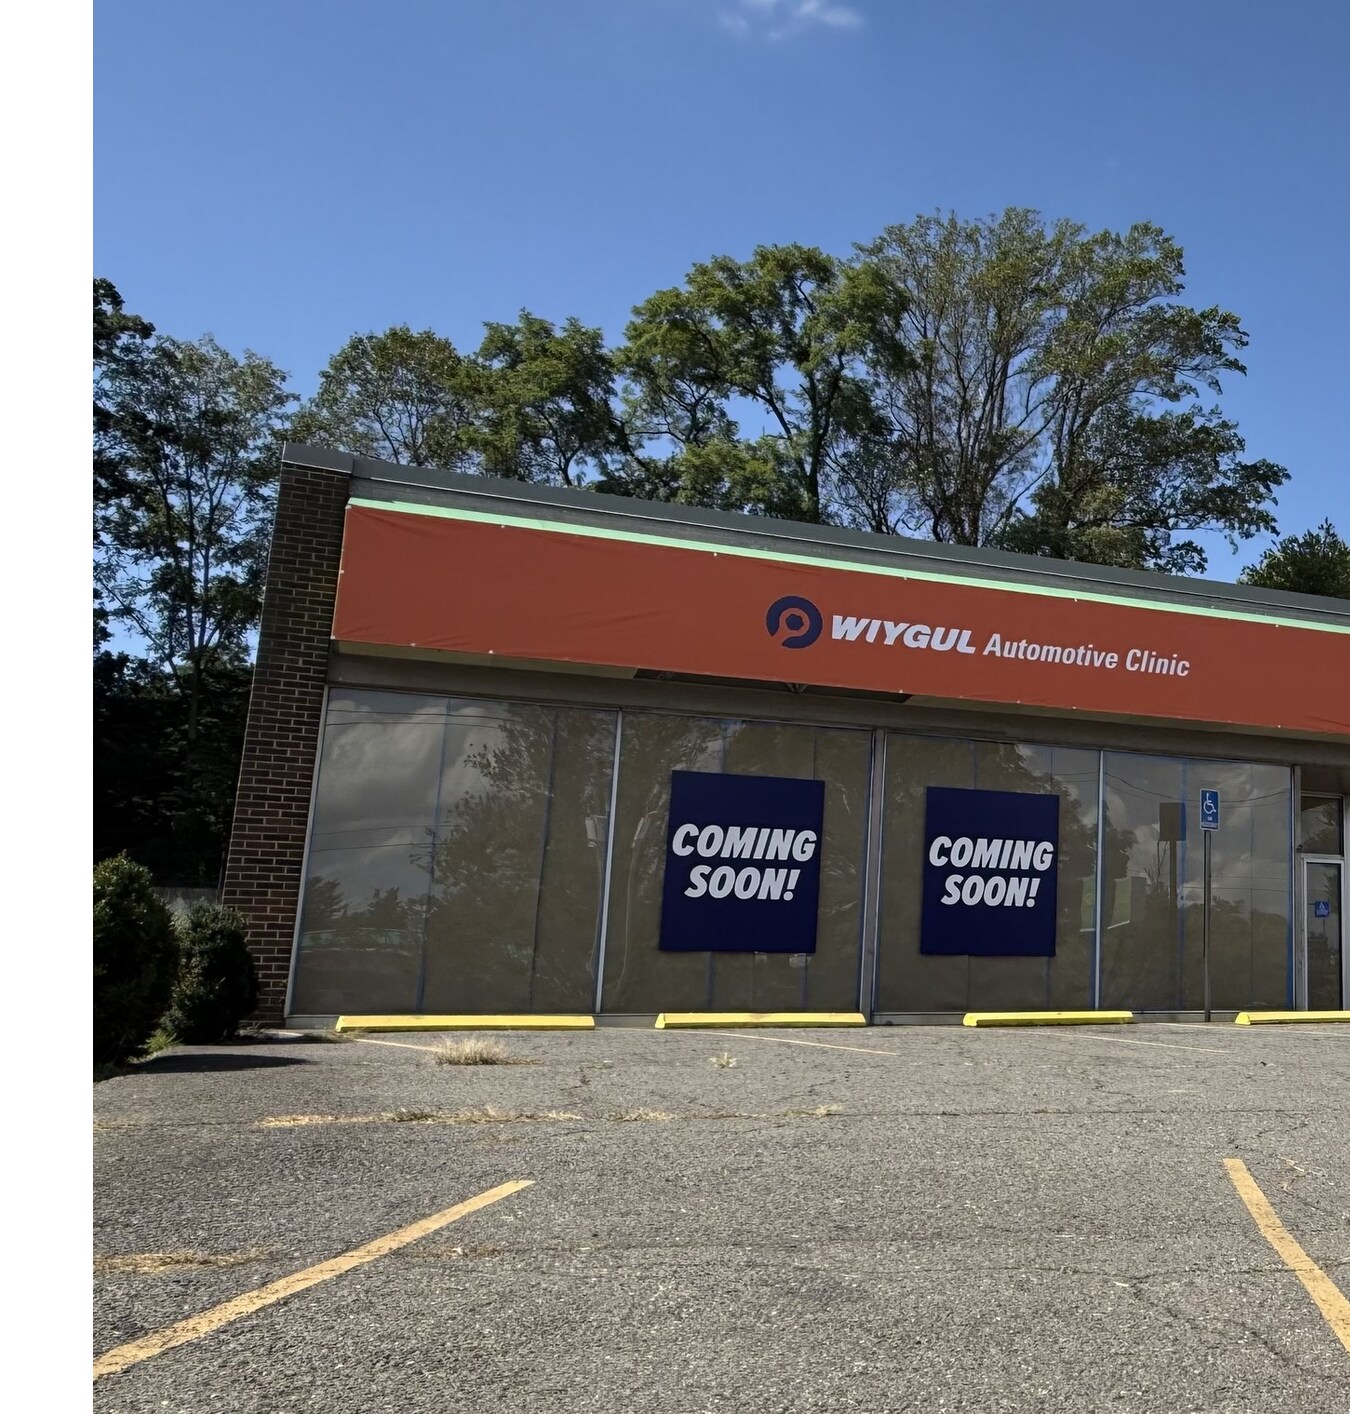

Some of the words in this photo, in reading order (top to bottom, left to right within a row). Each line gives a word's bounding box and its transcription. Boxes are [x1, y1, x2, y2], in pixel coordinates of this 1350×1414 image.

[831, 614, 977, 657] WIYGUL
[983, 632, 1119, 673] Automotive
[1125, 648, 1191, 677] Clinic
[672, 823, 817, 862] COMING
[928, 835, 1054, 871] COMING
[684, 864, 801, 901] SOON!
[940, 874, 1041, 908] SOON!
